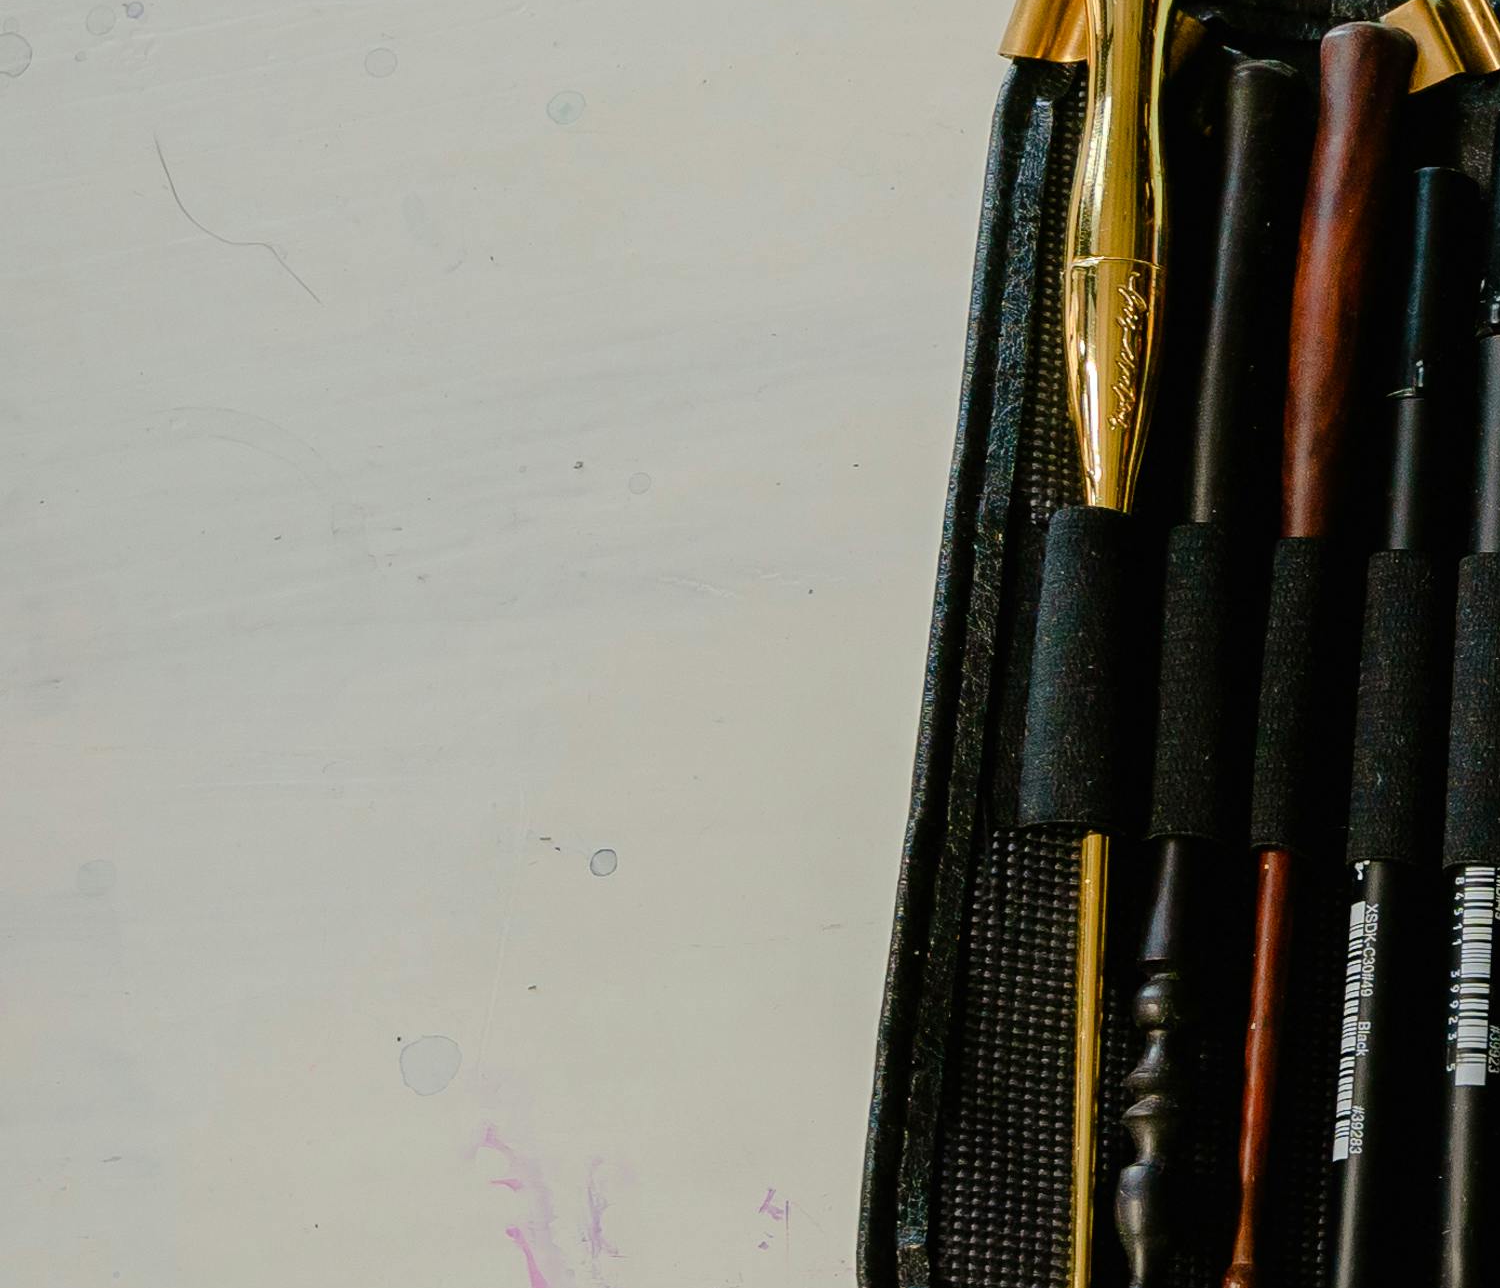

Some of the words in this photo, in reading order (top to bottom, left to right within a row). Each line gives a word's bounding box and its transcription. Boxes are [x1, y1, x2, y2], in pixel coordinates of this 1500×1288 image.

[1360, 903, 1379, 997] XSDK-C30#49
[1356, 1020, 1372, 1056] Black
[1350, 1104, 1366, 1155] #39283
